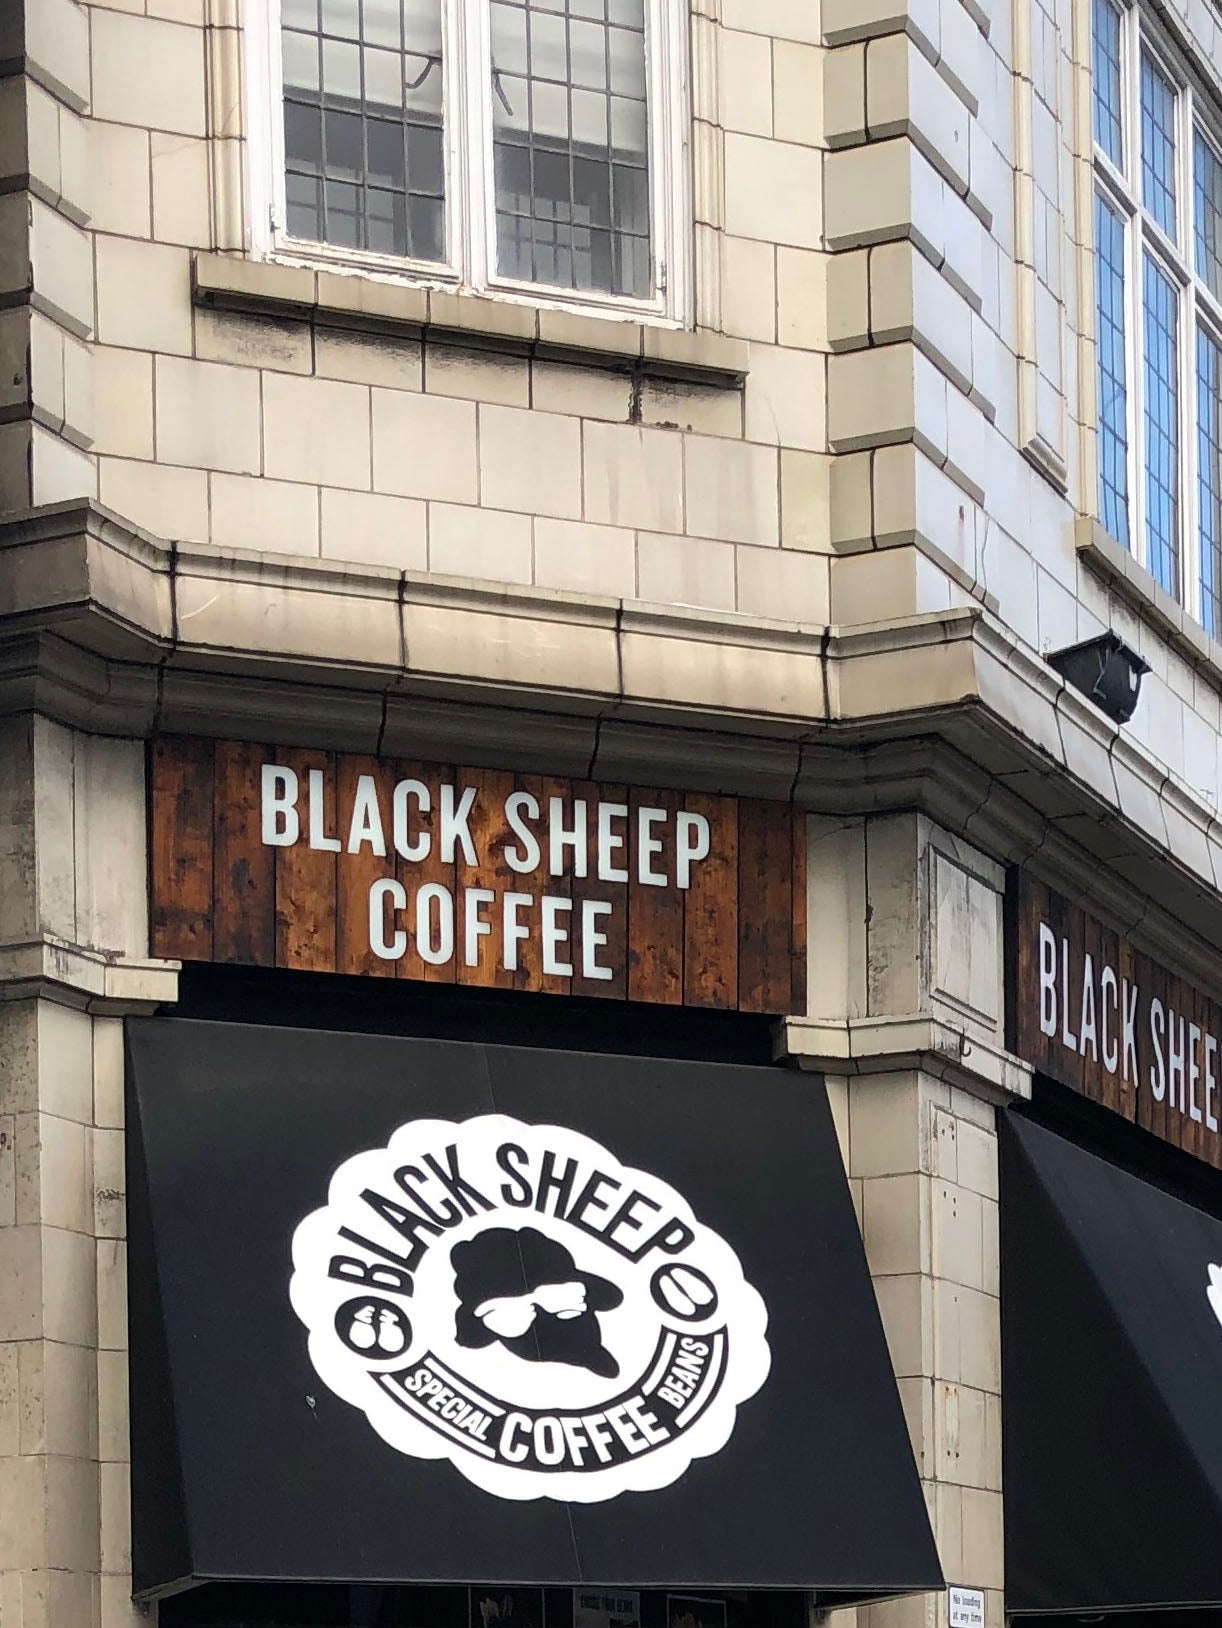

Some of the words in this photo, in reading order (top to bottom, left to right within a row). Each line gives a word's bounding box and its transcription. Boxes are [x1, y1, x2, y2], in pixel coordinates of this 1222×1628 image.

[261, 764, 477, 867] BLACK
[504, 791, 711, 889] SHEEP
[369, 879, 614, 980] COFFEE
[1039, 920, 1138, 1088] BLACK
[328, 1143, 498, 1297] BLACK
[496, 1142, 695, 1264] SHEEP
[404, 1368, 491, 1441] SPECIAL
[500, 1395, 671, 1467] COFFEE
[658, 1336, 709, 1409] BEANS
